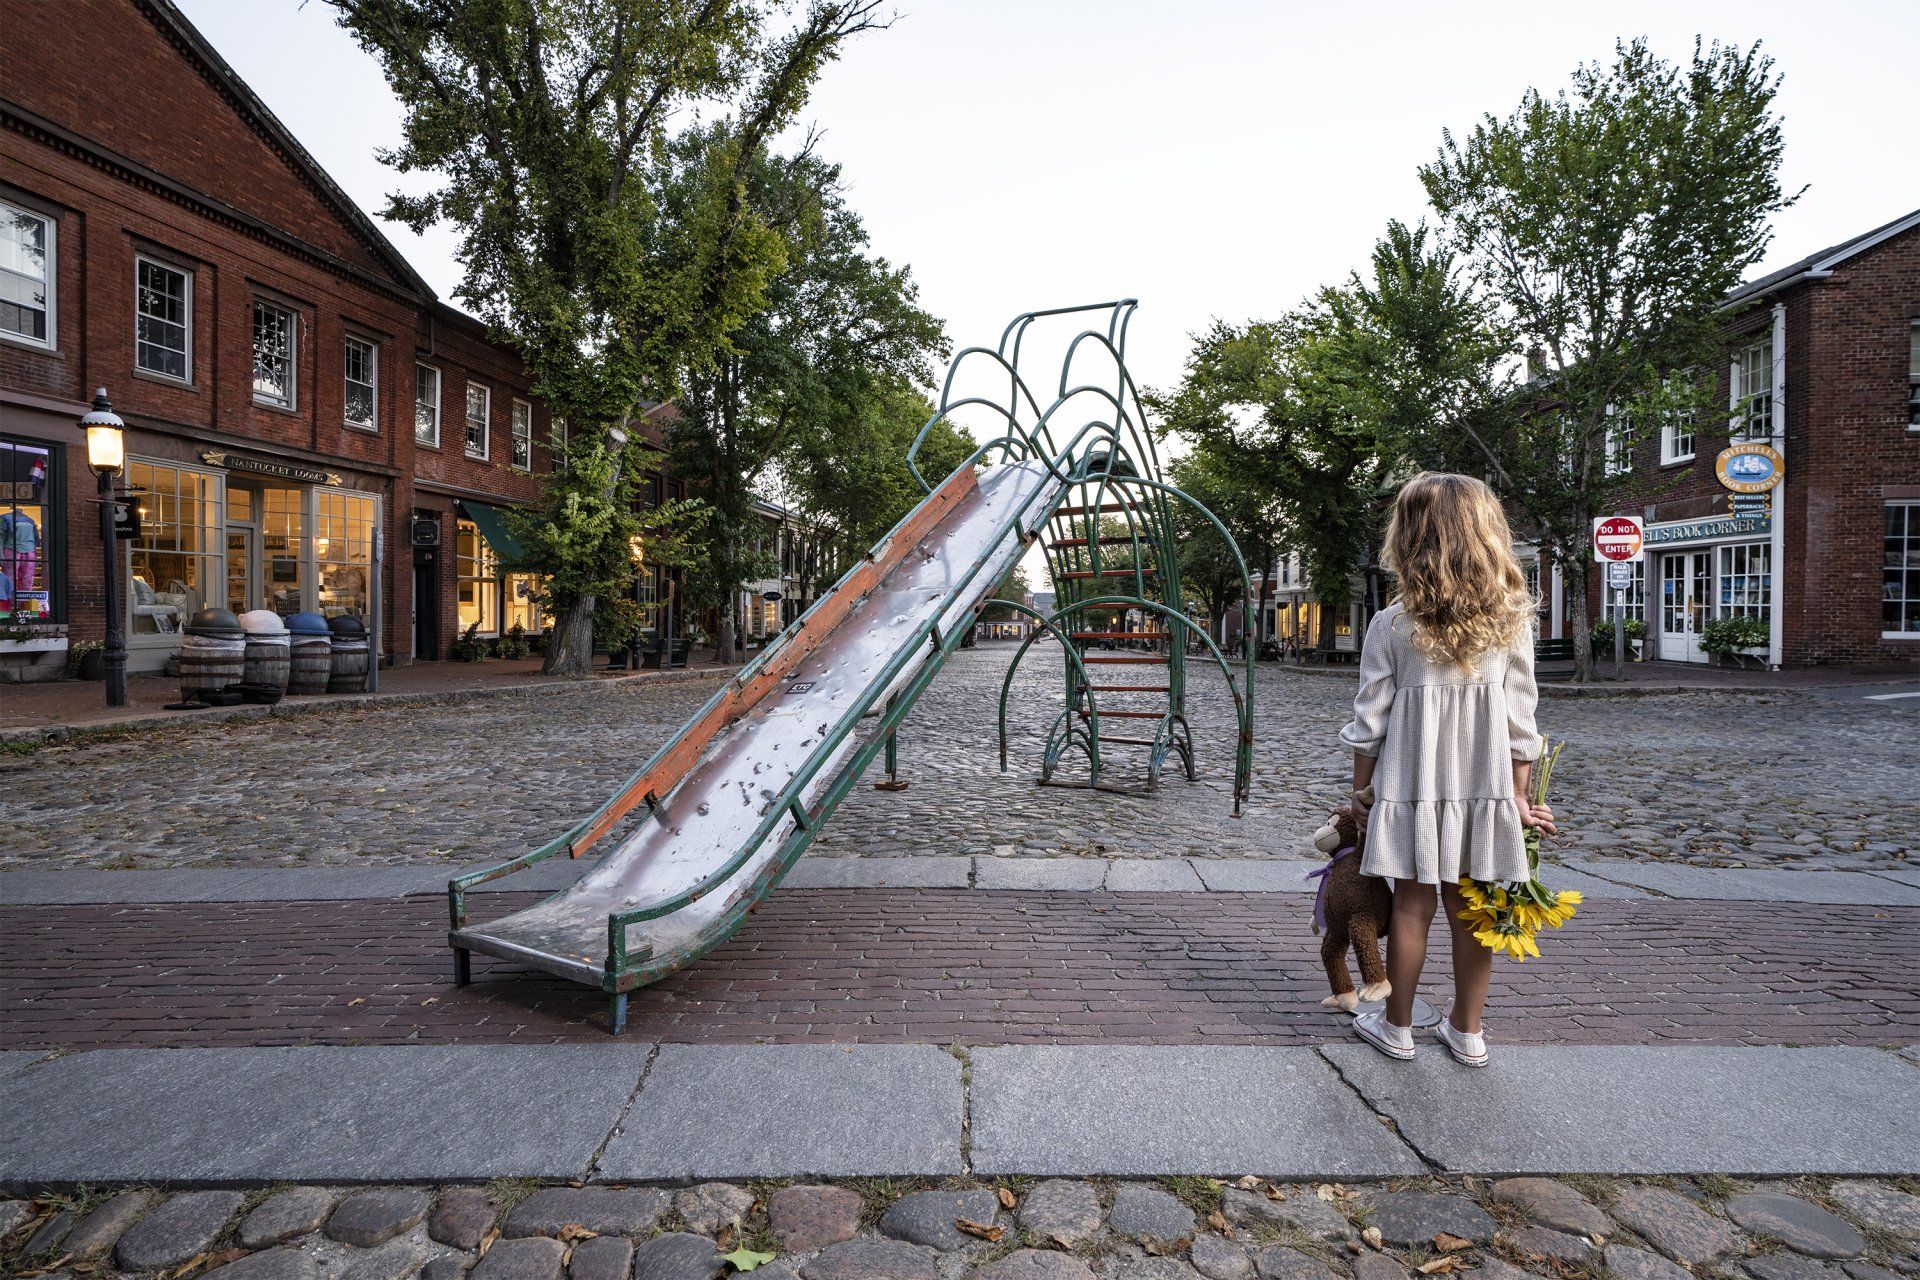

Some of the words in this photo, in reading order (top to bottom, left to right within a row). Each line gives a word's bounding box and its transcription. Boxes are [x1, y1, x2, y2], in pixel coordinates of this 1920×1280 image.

[231, 458, 290, 476] NANTUCKET
[294, 469, 323, 481] LOOMS
[1718, 471, 1741, 490] BOOK
[1746, 471, 1782, 491] CORNER
[1601, 525, 1613, 534] DO
[1618, 525, 1635, 533] NOT
[1672, 525, 1702, 540] BOOK
[1705, 519, 1755, 536] CORNER
[1605, 545, 1632, 553] ENTER
